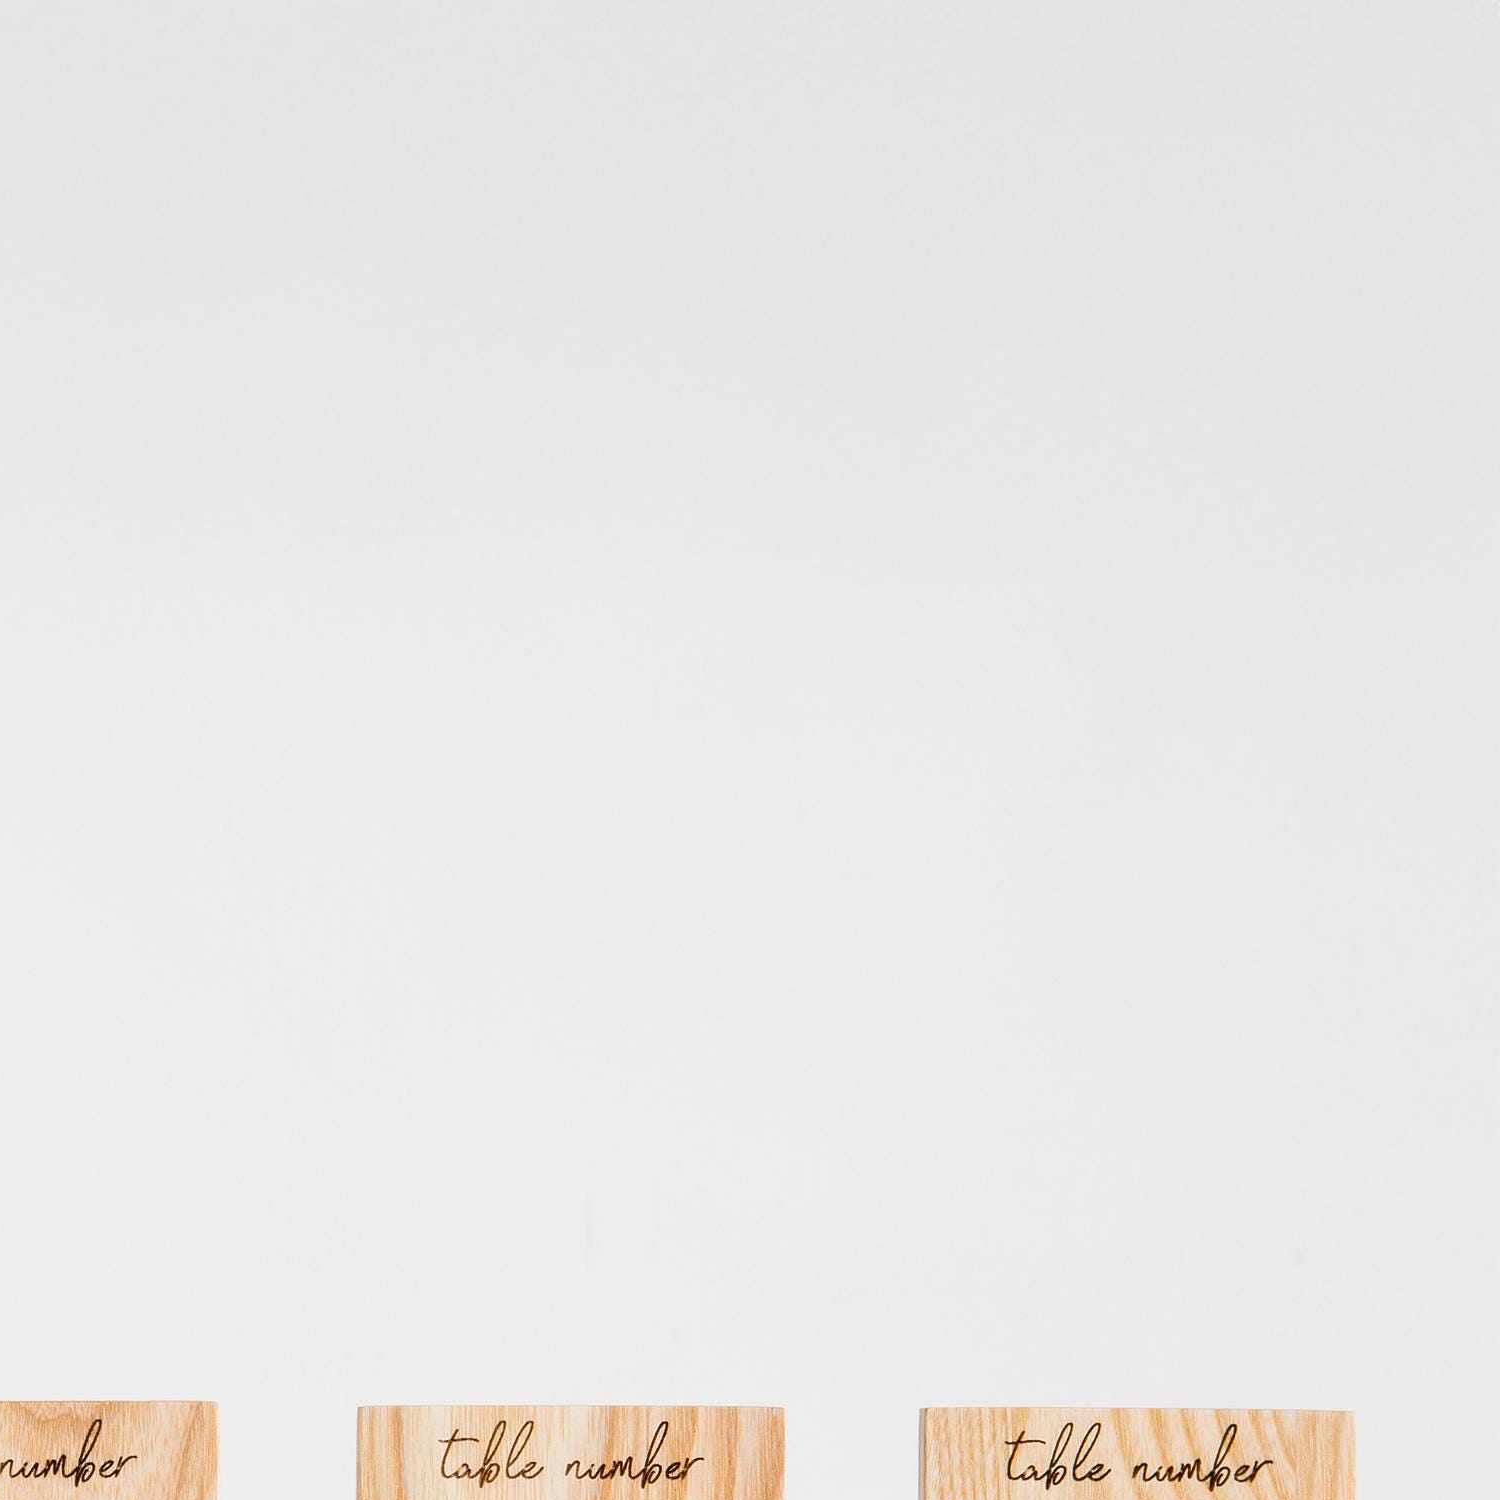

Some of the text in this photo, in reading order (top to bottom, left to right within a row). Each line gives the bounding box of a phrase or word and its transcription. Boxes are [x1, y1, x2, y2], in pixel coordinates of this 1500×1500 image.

[438, 1420, 705, 1490] table number
[1004, 1422, 1274, 1491] table number
